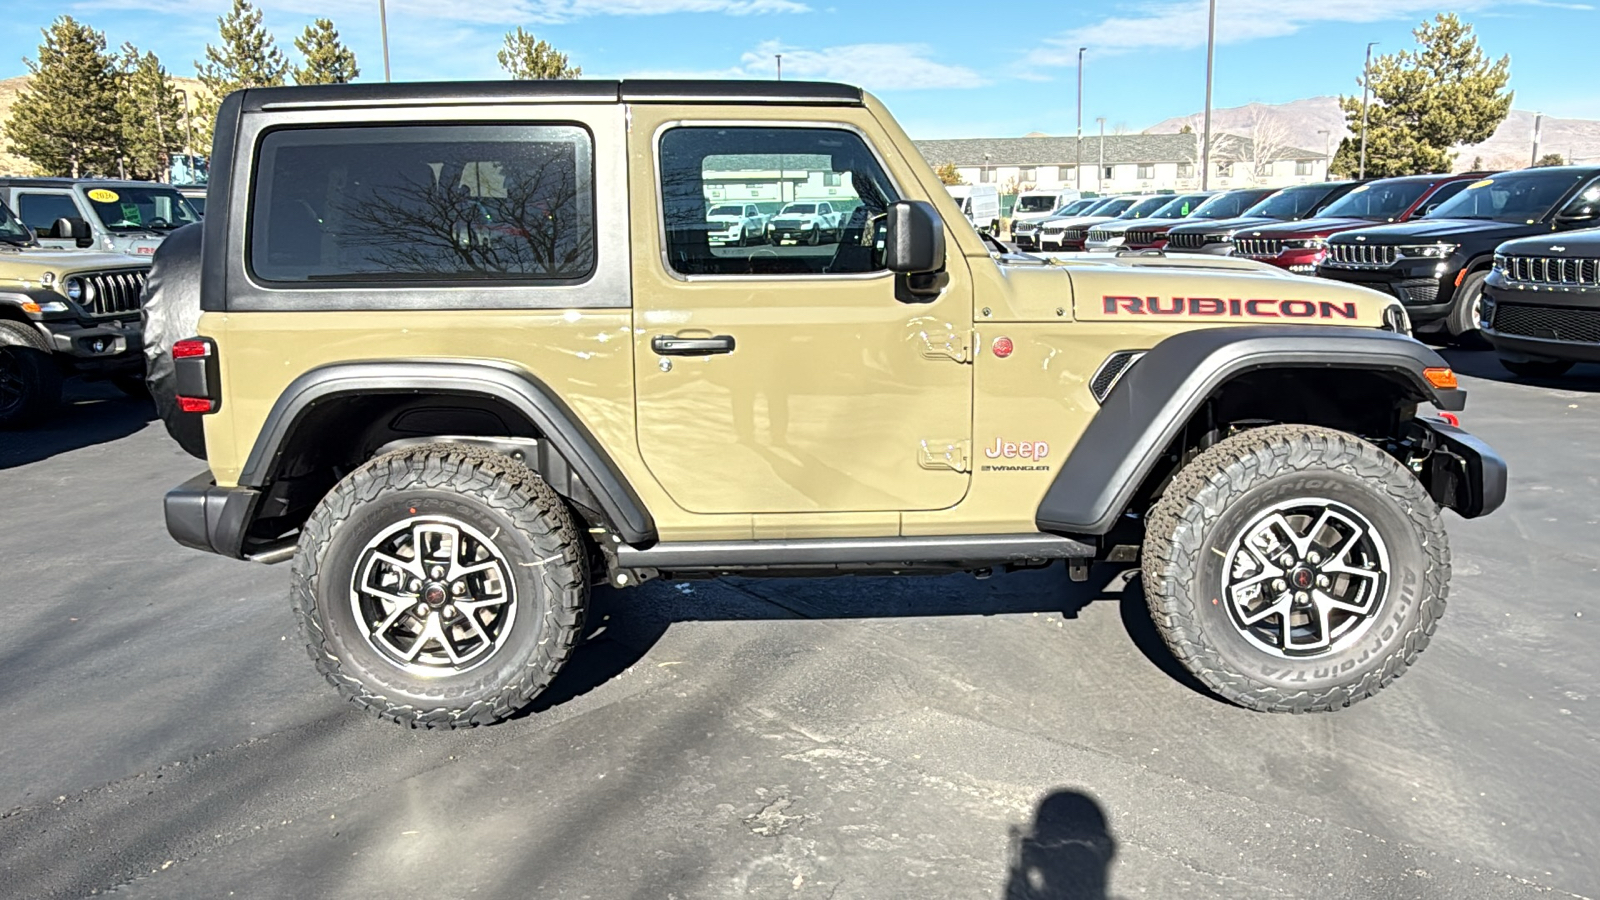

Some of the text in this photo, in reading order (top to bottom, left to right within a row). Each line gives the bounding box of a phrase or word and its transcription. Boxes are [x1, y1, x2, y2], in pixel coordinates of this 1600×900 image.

[1103, 295, 1358, 319] RUBICON
[985, 437, 1049, 462] Jeep
[1260, 566, 1416, 683] All-Terrain T/A
